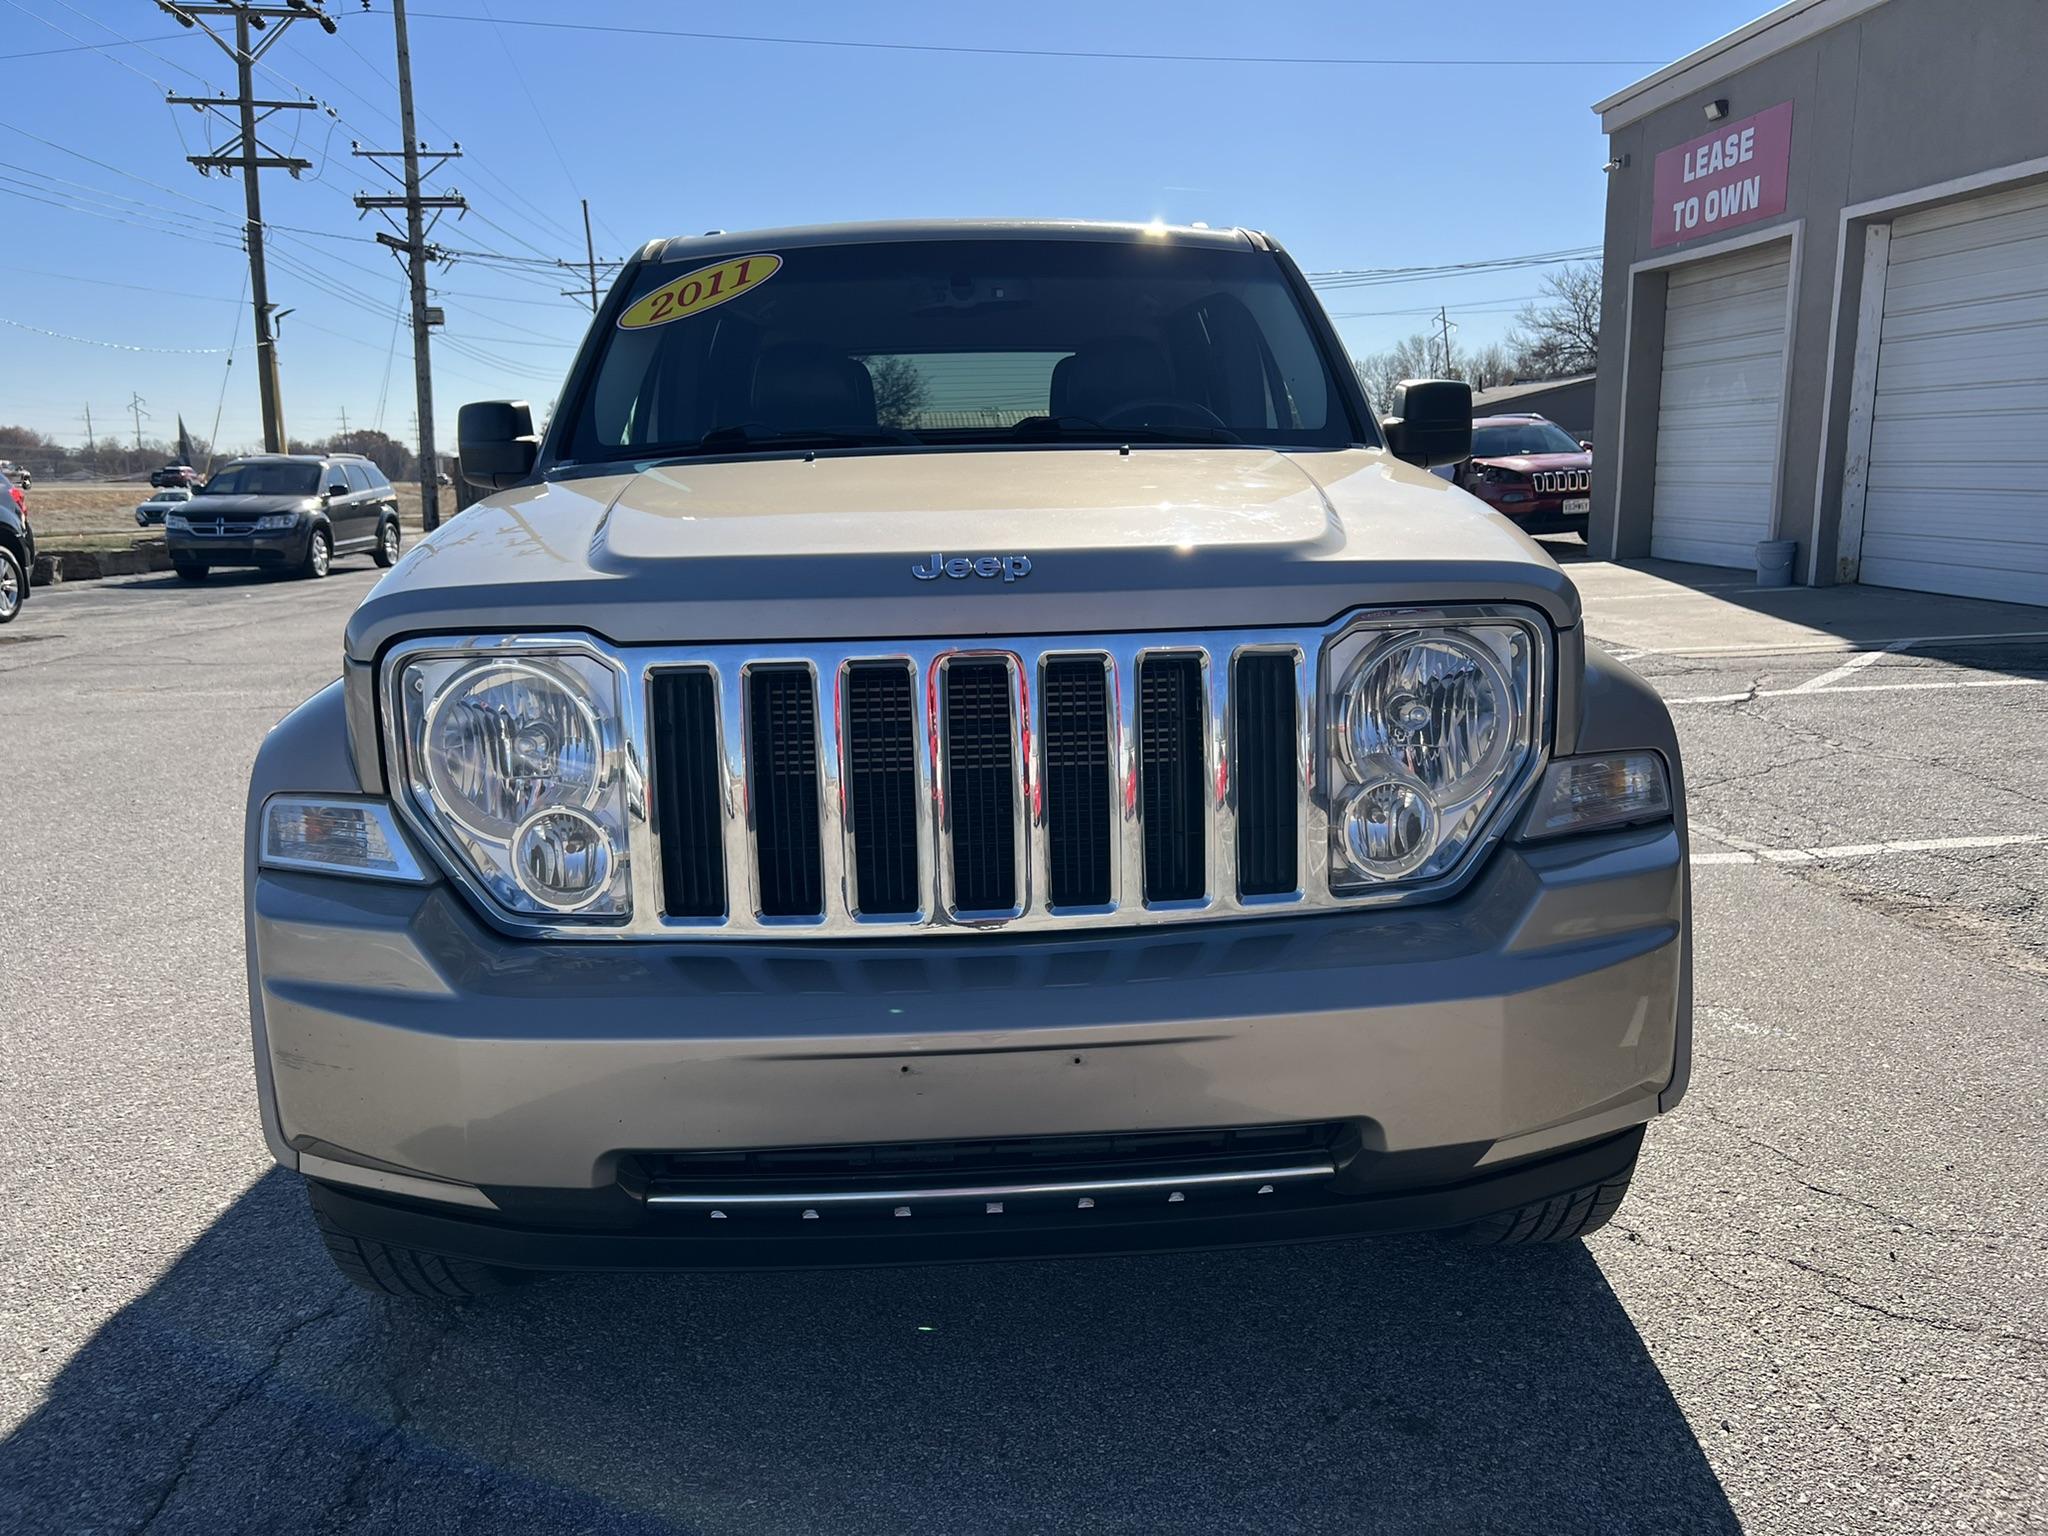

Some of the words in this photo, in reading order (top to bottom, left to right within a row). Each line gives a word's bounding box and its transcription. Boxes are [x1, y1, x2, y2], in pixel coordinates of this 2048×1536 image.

[1683, 127, 1755, 183] LEASE
[1673, 197, 1699, 232] TO
[1704, 175, 1761, 223] OWN
[649, 260, 752, 321] 2011
[912, 553, 1032, 582] Jeep
